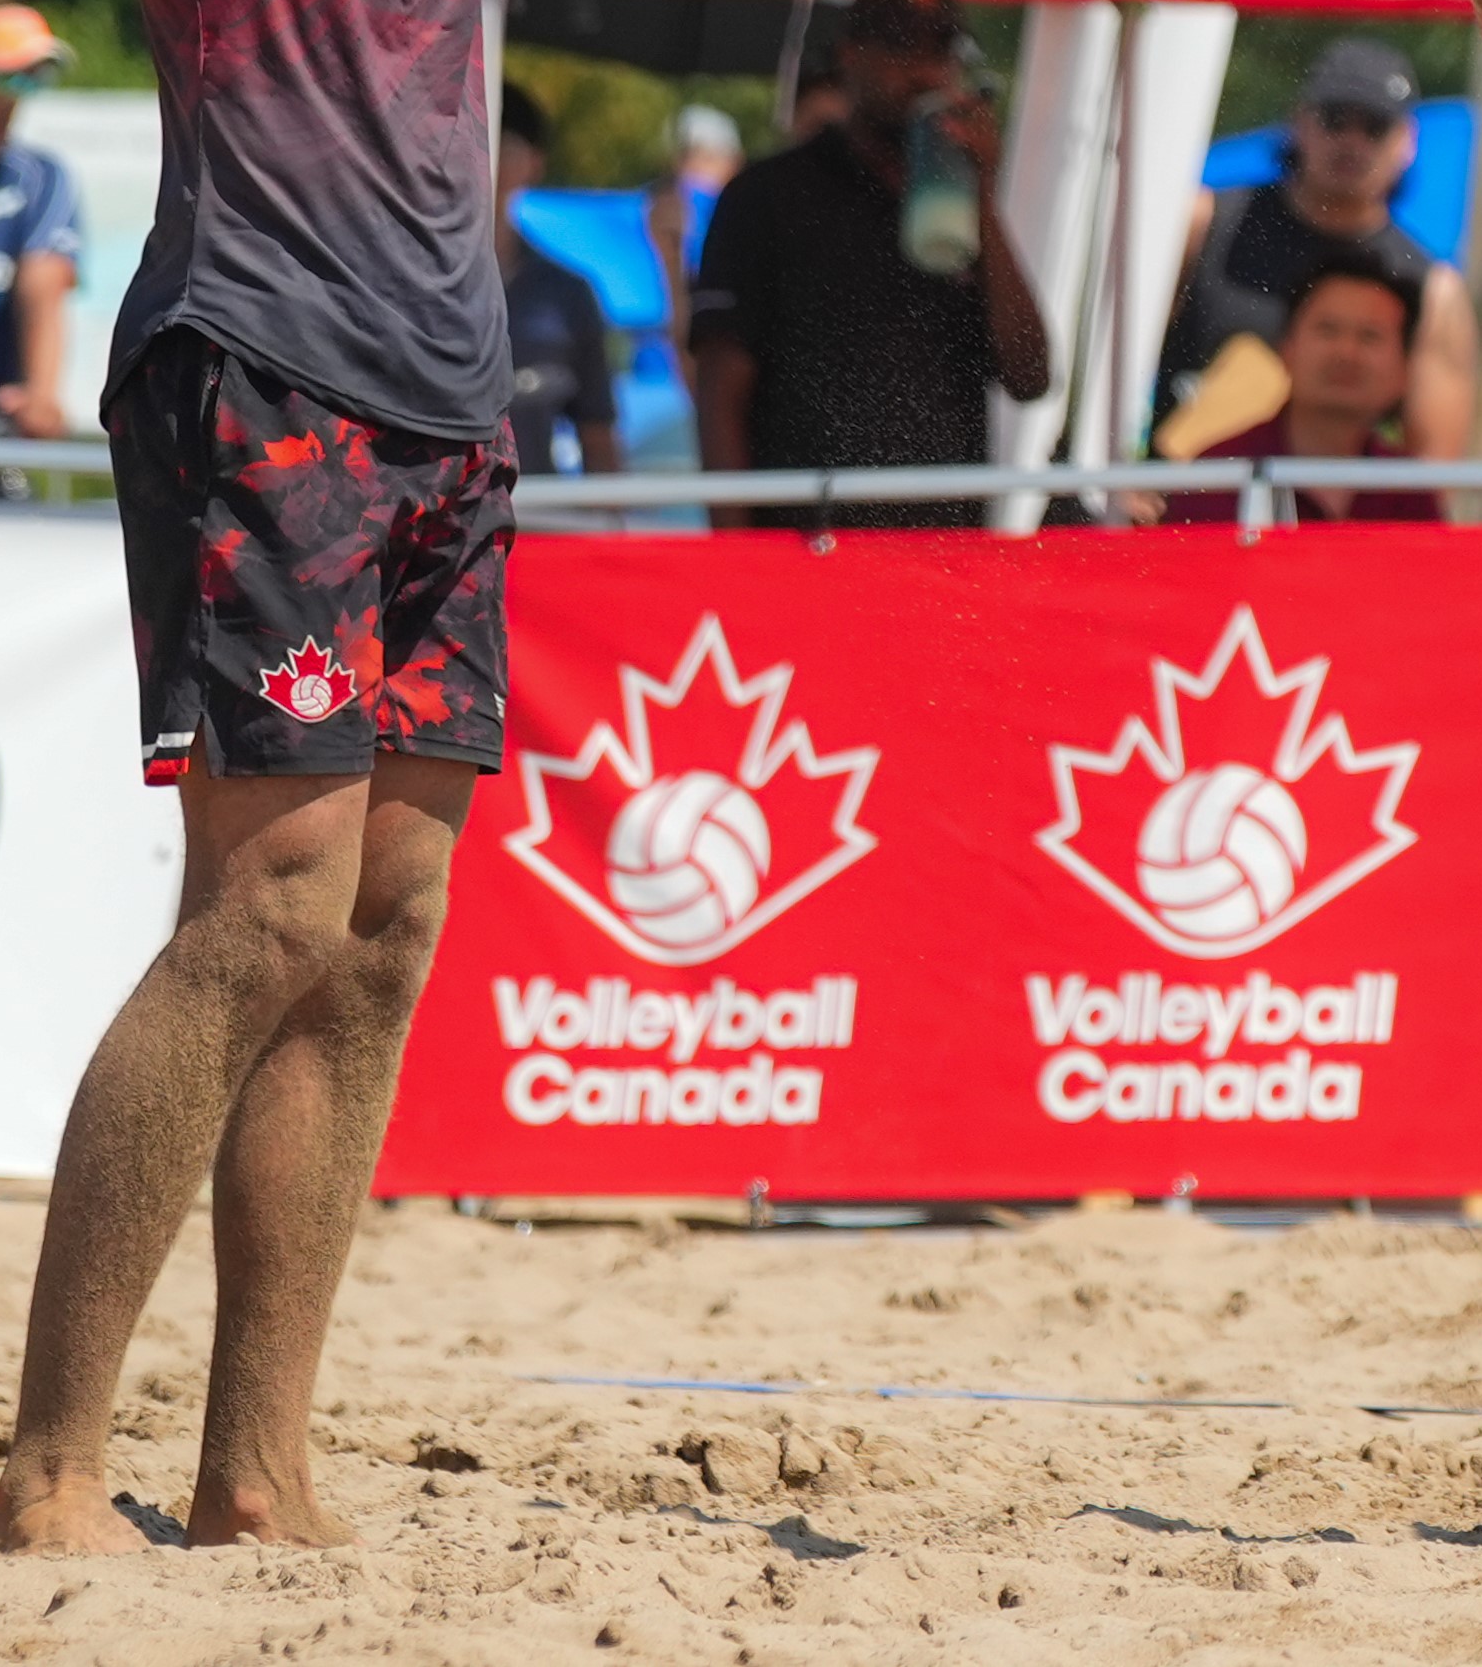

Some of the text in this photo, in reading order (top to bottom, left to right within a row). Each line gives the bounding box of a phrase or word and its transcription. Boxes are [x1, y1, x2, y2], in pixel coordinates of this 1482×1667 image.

[491, 974, 858, 1064] Volleyball
[1025, 969, 1398, 1059] Volleyball
[502, 1052, 824, 1126] Canada
[1036, 1046, 1363, 1123] Canada
